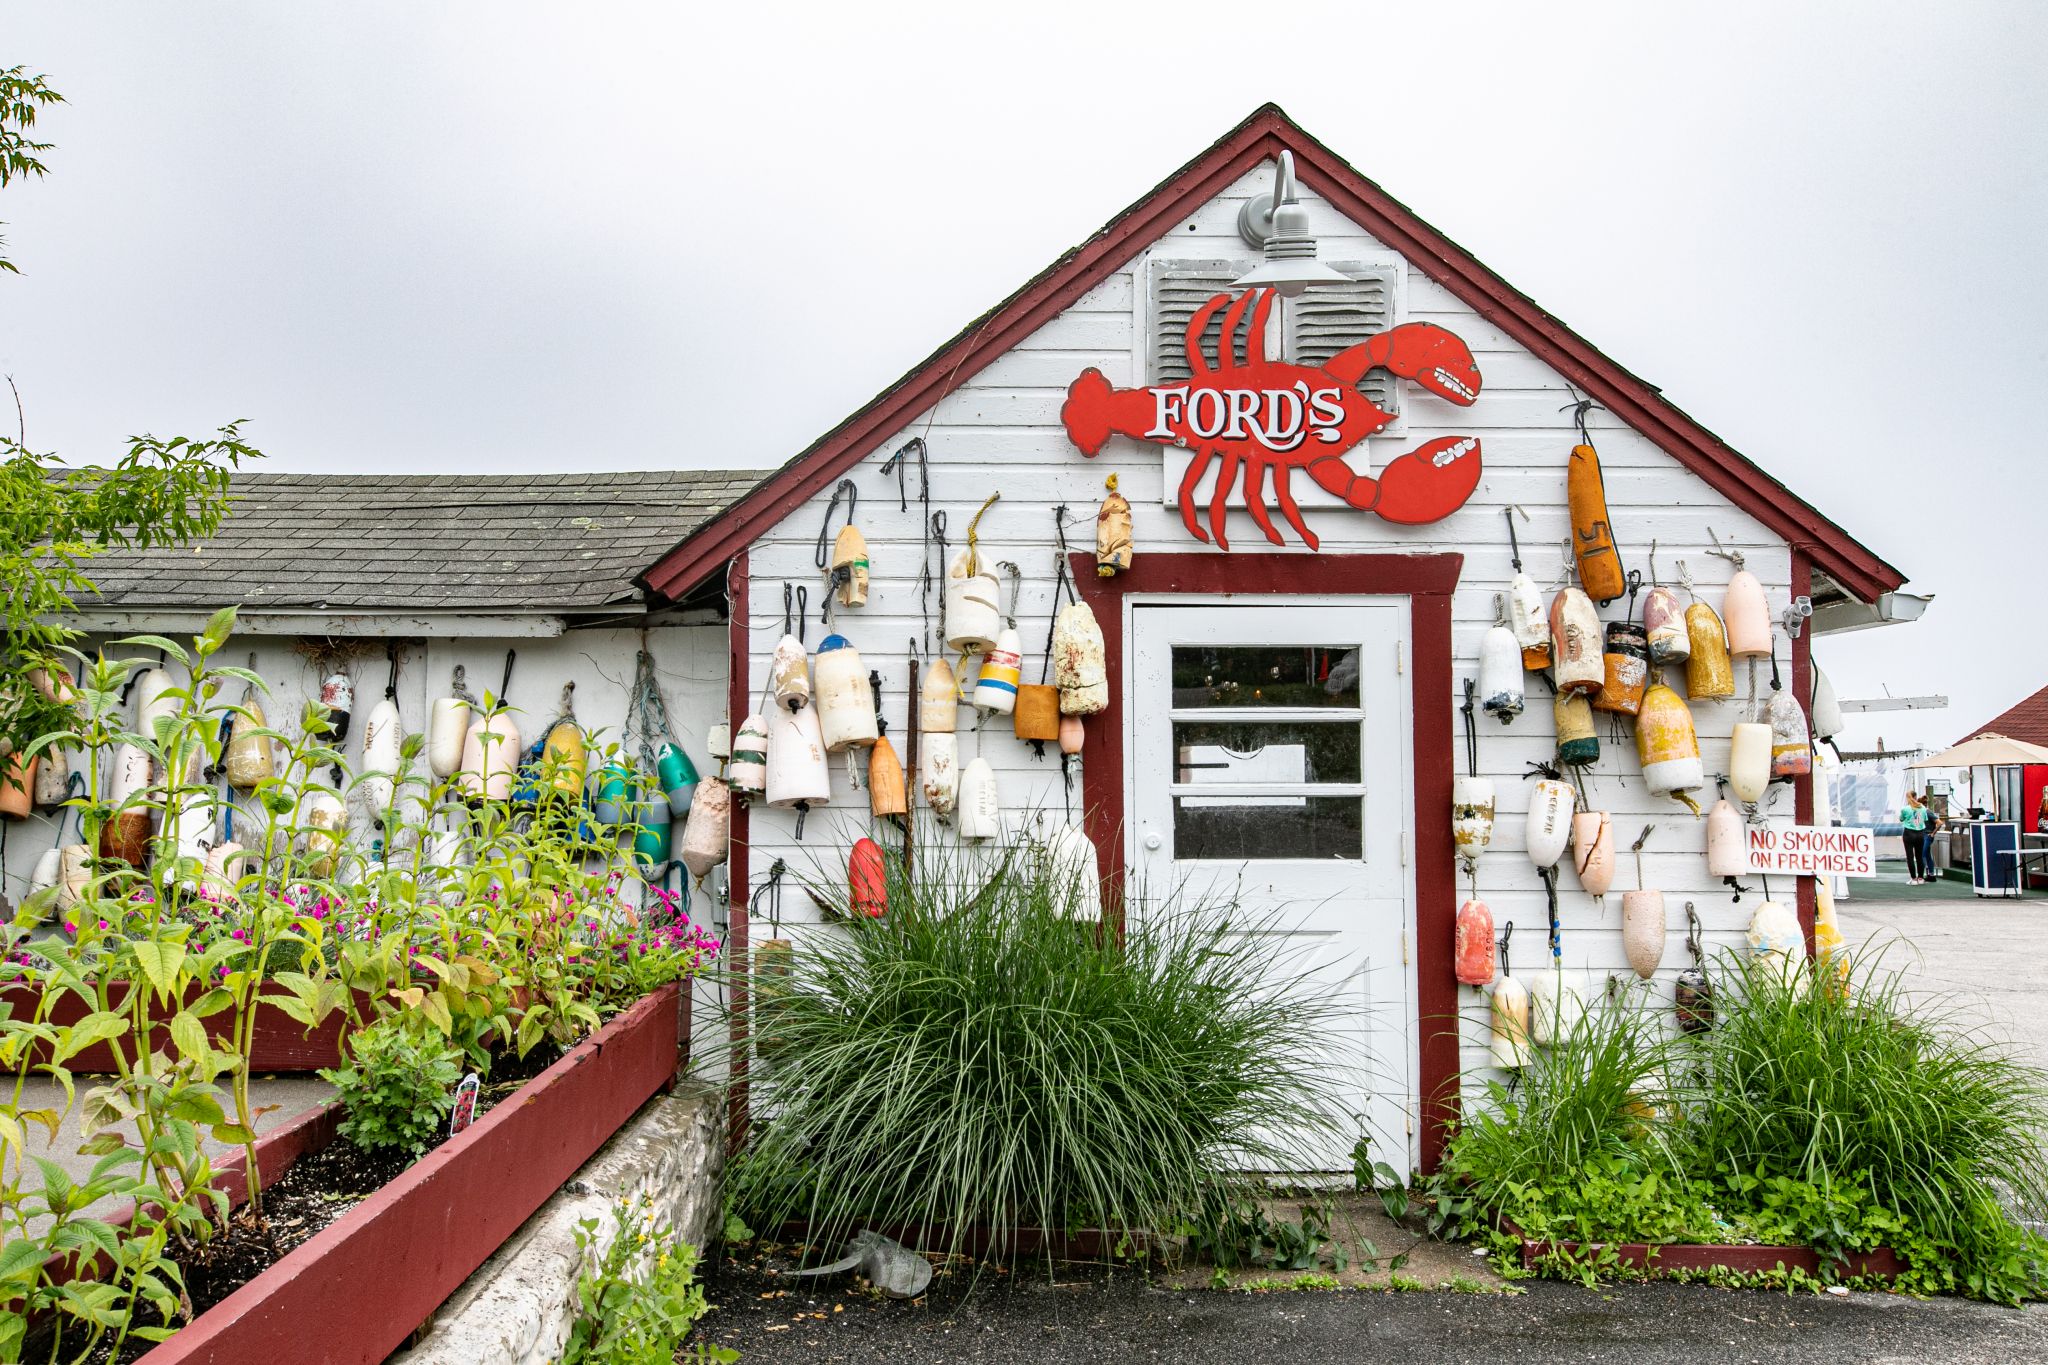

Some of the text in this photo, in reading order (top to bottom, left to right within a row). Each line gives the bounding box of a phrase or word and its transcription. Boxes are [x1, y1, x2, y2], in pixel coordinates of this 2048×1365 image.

[1144, 380, 1346, 453] FORD'S
[1750, 829, 1869, 853] NO SMOKING
[1750, 851, 1869, 873] ON PREMISES
